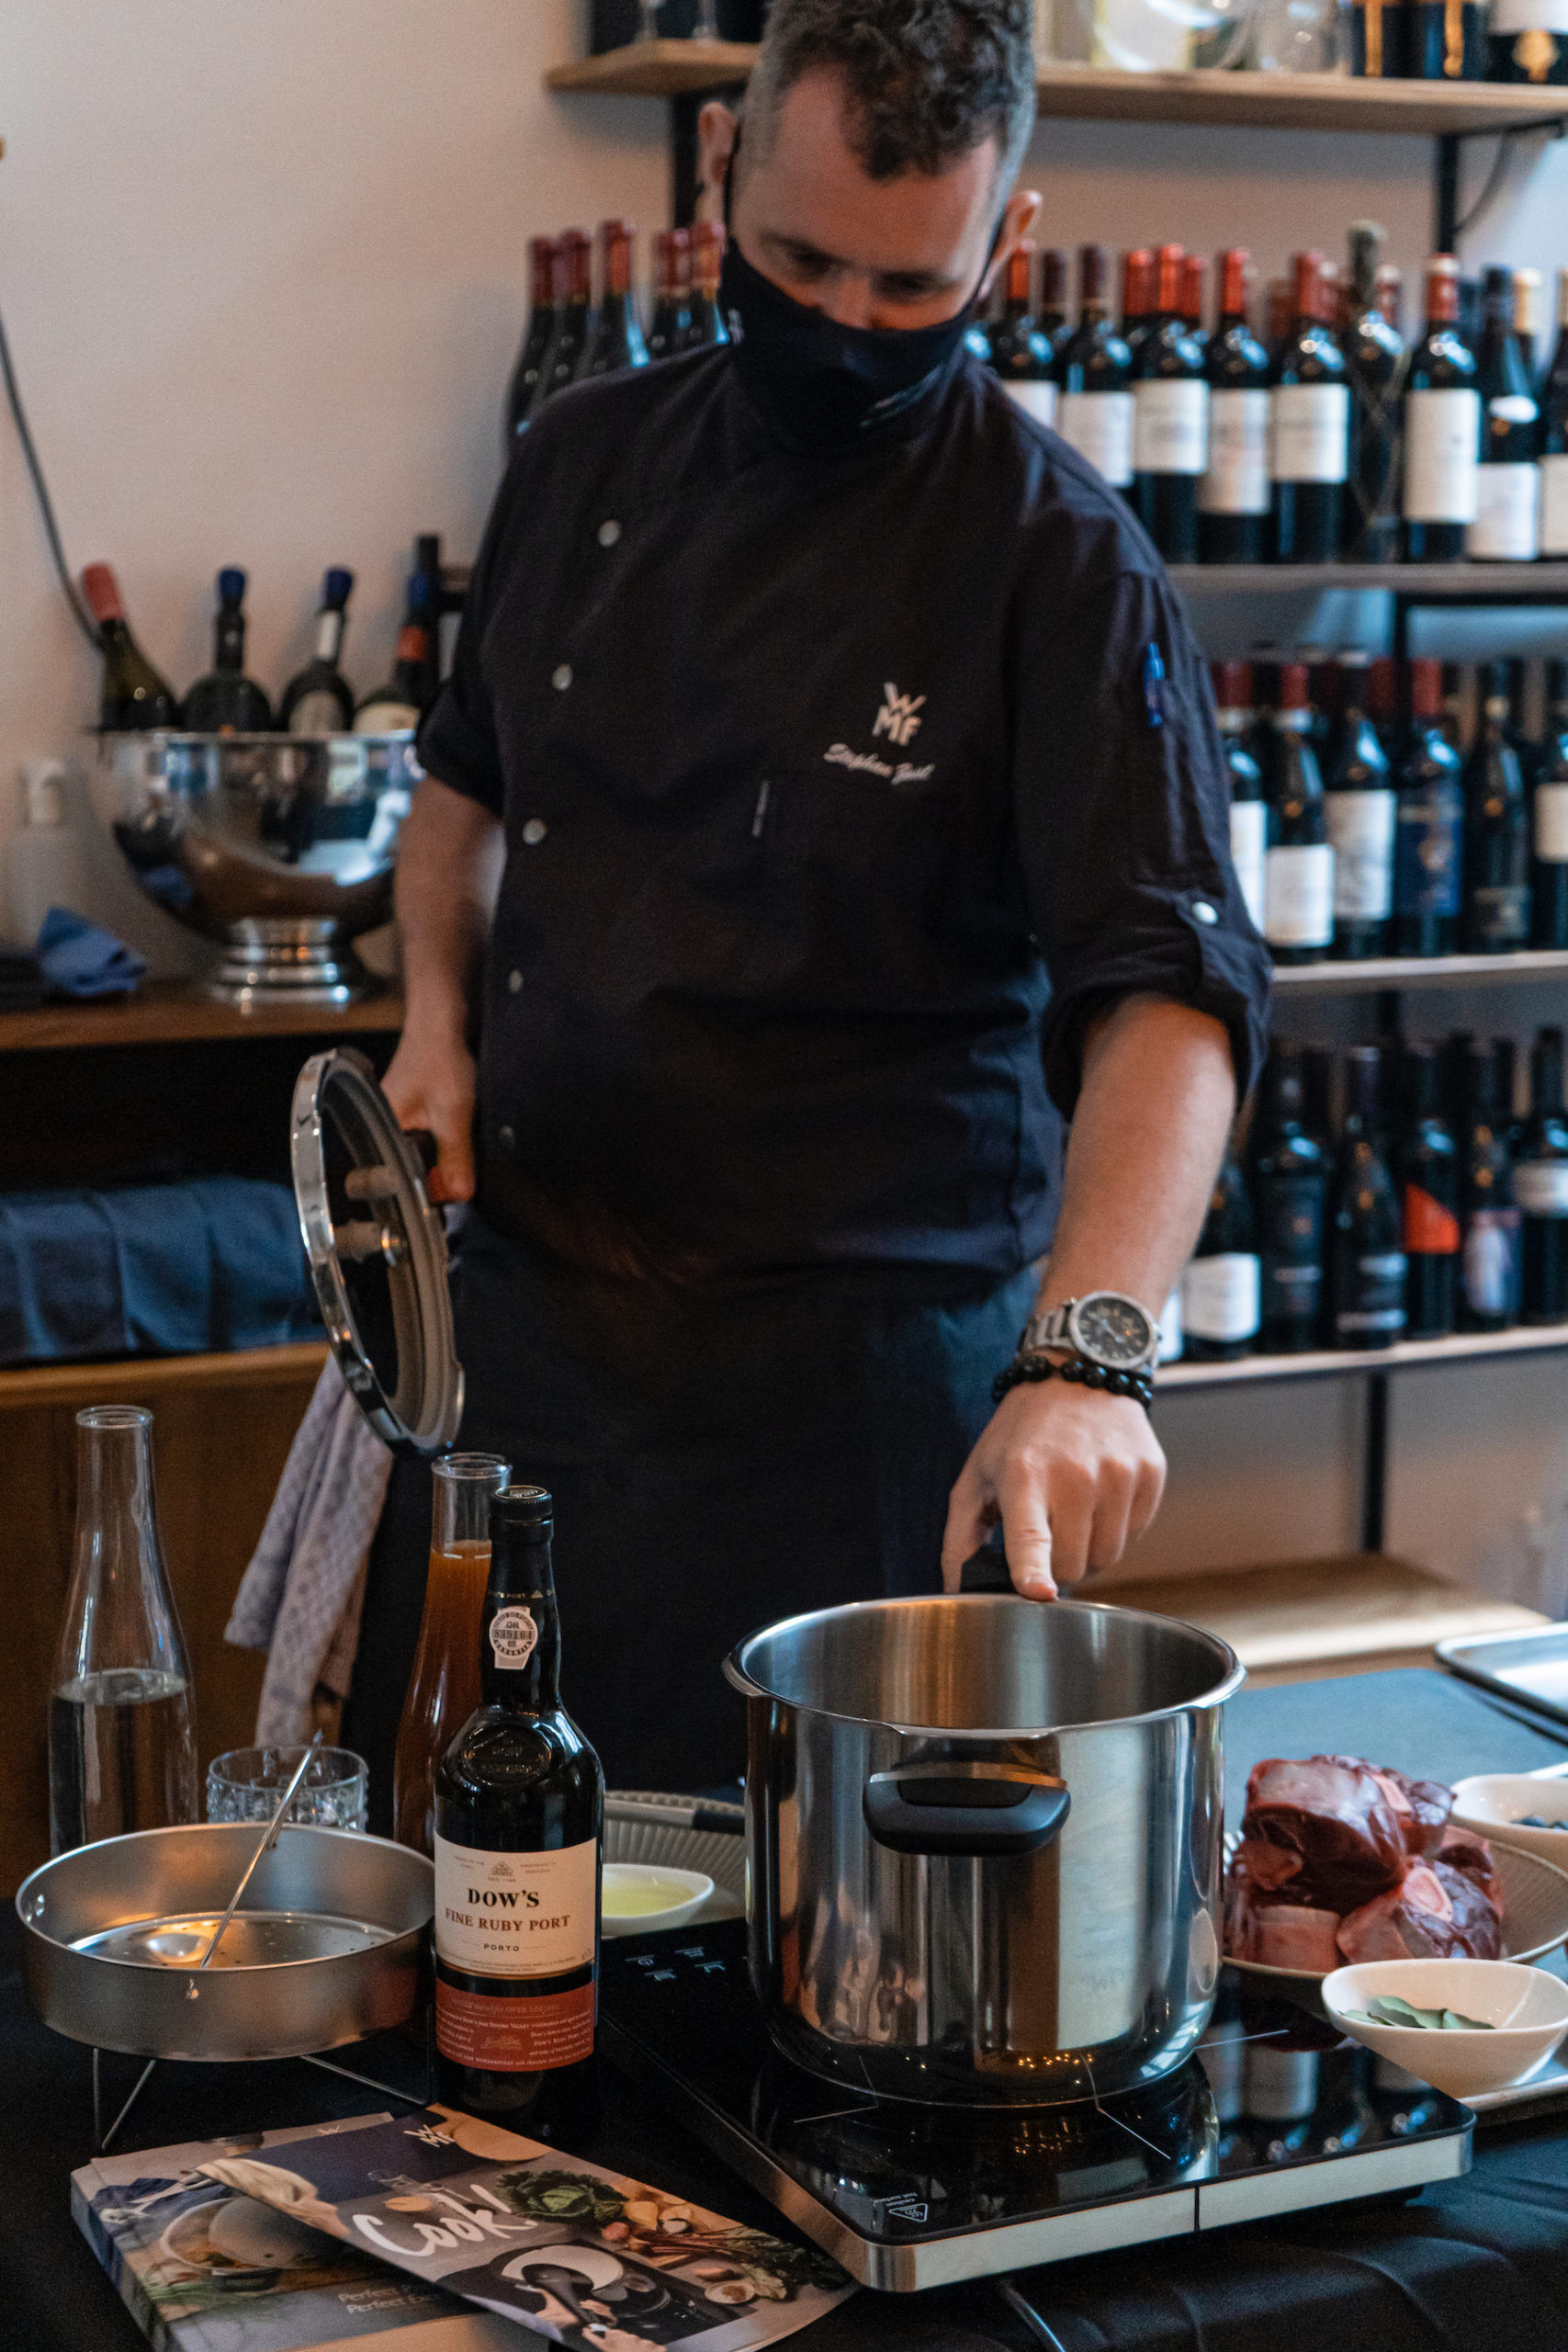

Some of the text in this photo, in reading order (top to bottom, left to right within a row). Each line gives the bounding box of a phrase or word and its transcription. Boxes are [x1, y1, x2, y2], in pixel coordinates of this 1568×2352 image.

[873, 682, 927, 746] WMF
[467, 1887, 540, 1909] DOW'S
[445, 1907, 571, 1932] FINE RUBY PORT
[483, 1943, 520, 1952] PORTO
[403, 2123, 457, 2148] WMF
[337, 2288, 400, 2302] Perfect
[345, 2298, 407, 2314] Perfect
